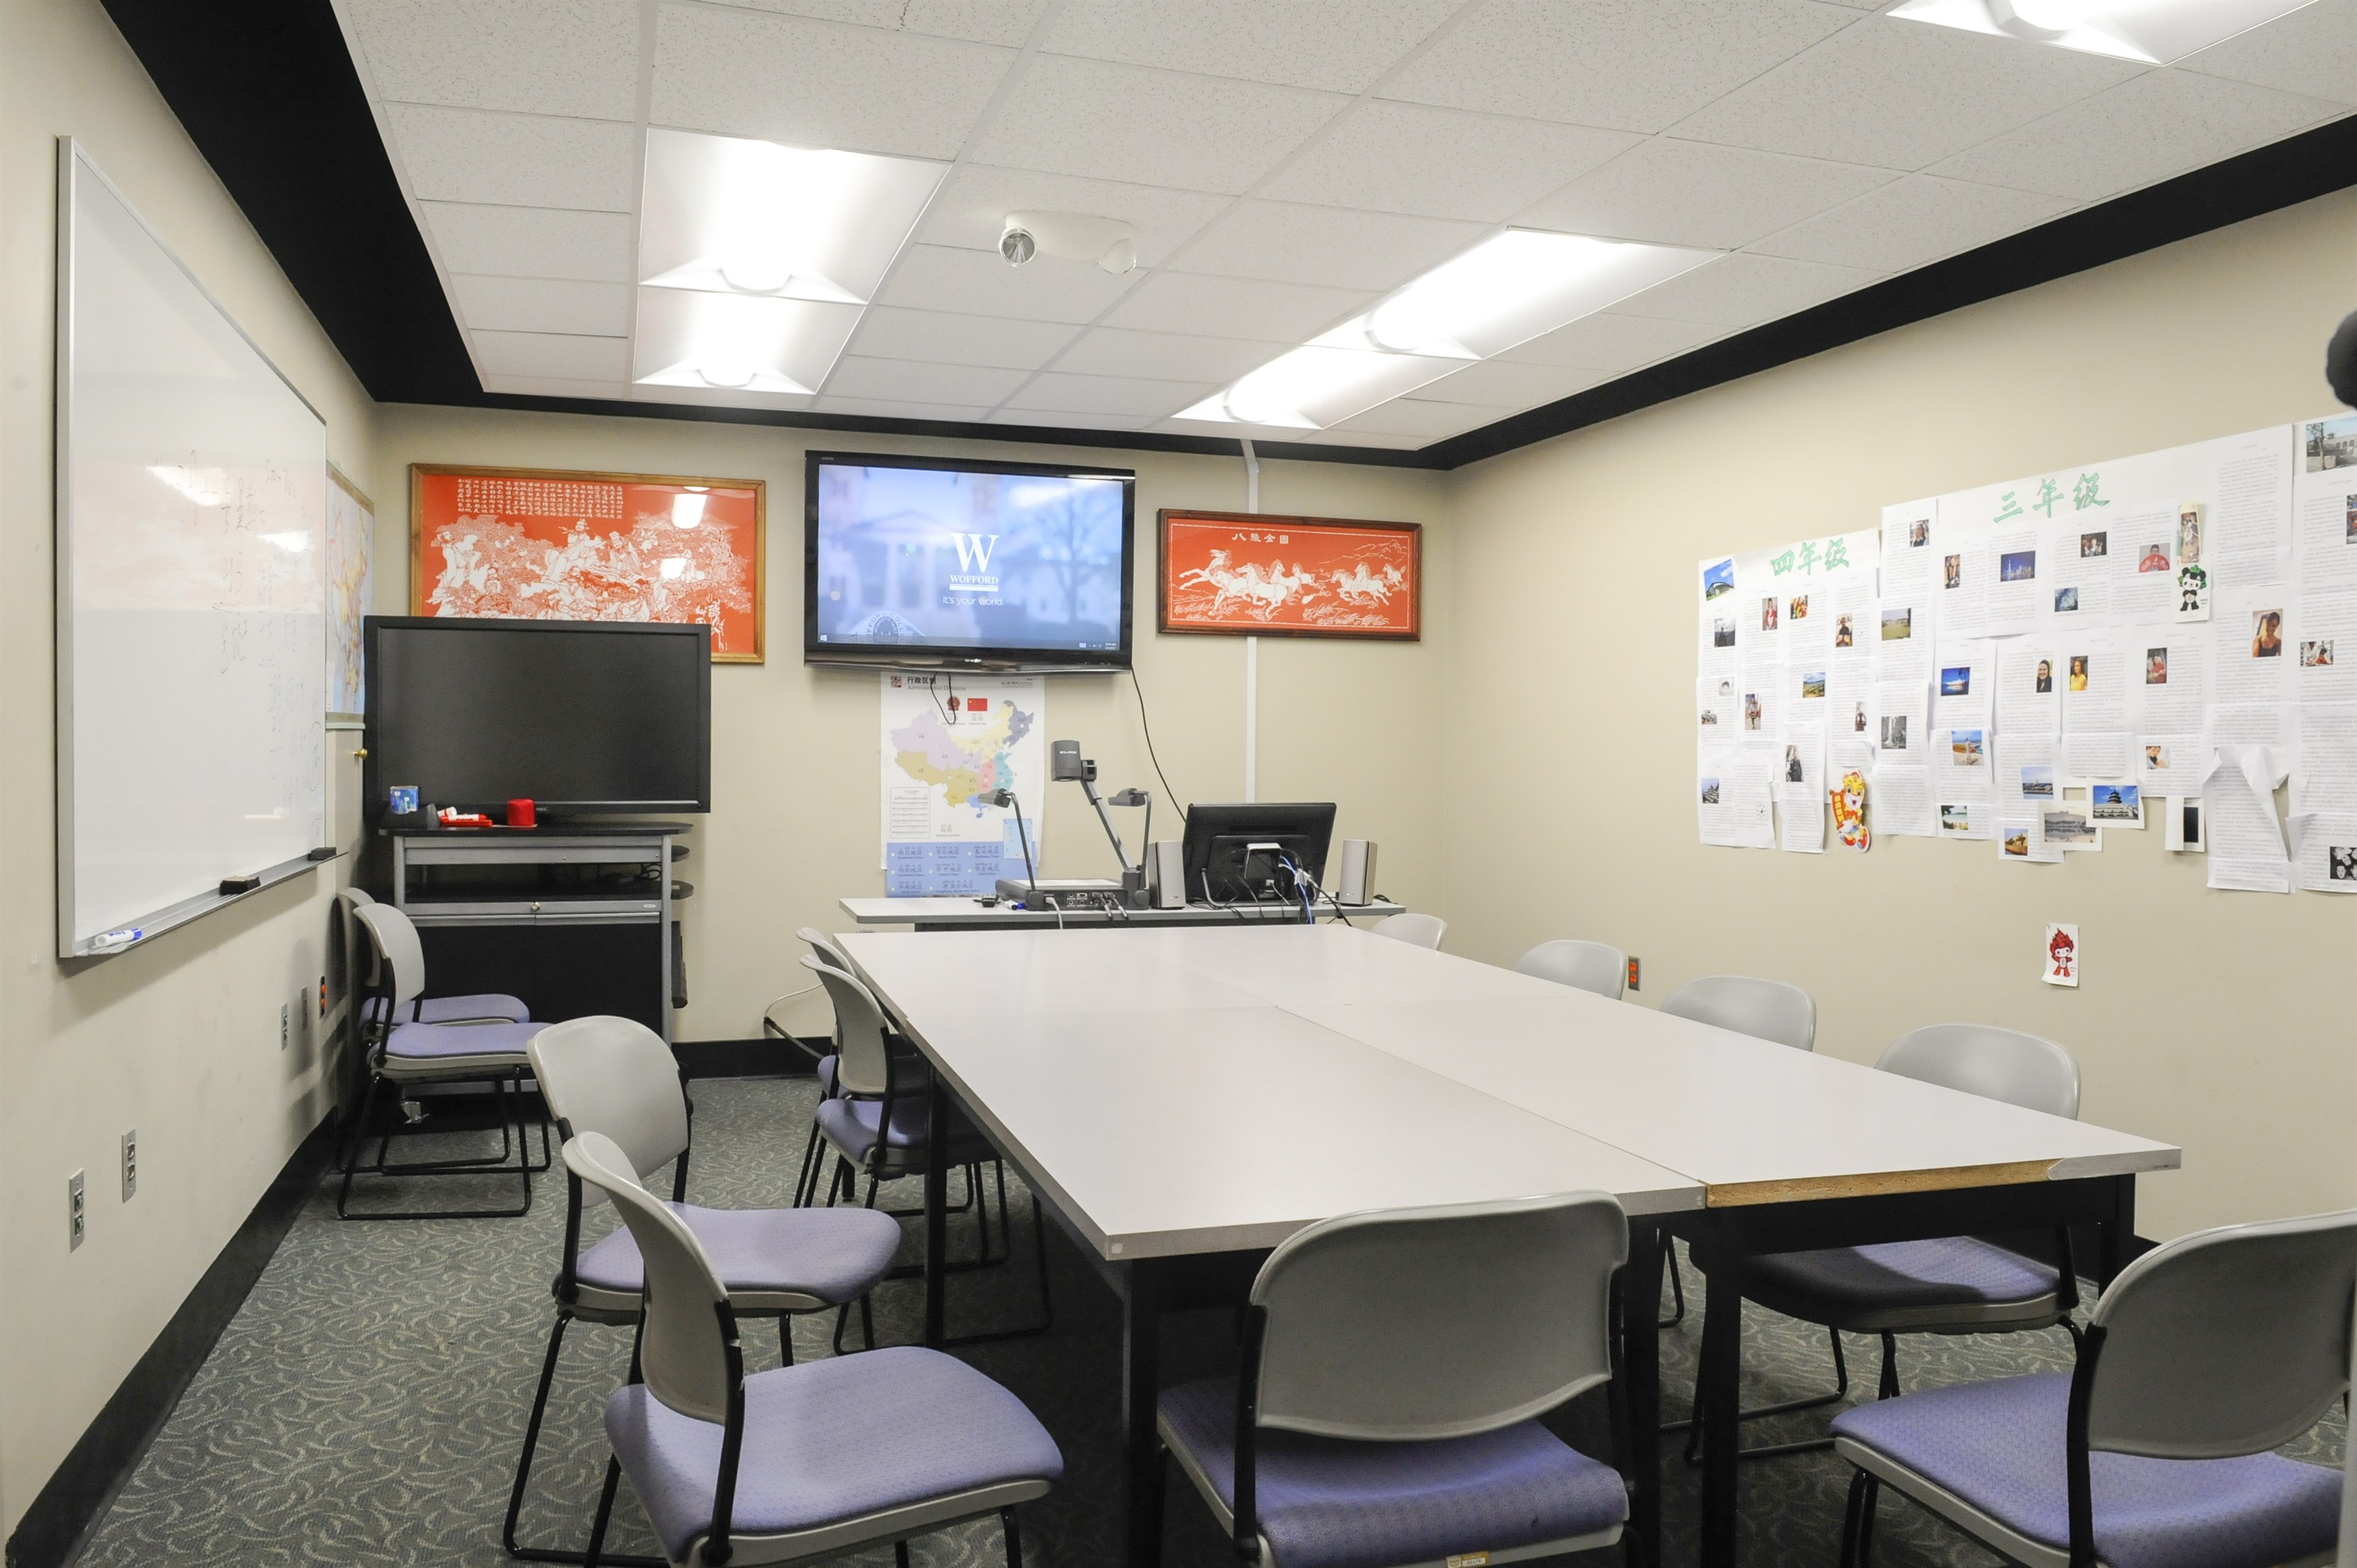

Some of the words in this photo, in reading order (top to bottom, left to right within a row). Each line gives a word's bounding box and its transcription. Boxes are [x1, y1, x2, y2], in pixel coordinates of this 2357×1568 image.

[1994, 473, 2110, 523] 三年级
[950, 533, 999, 573] W
[1770, 538, 1849, 576] 四年级
[949, 574, 999, 585] WOFFORD
[943, 595, 954, 604] It's
[956, 597, 977, 606] your
[978, 597, 1004, 606] world.
